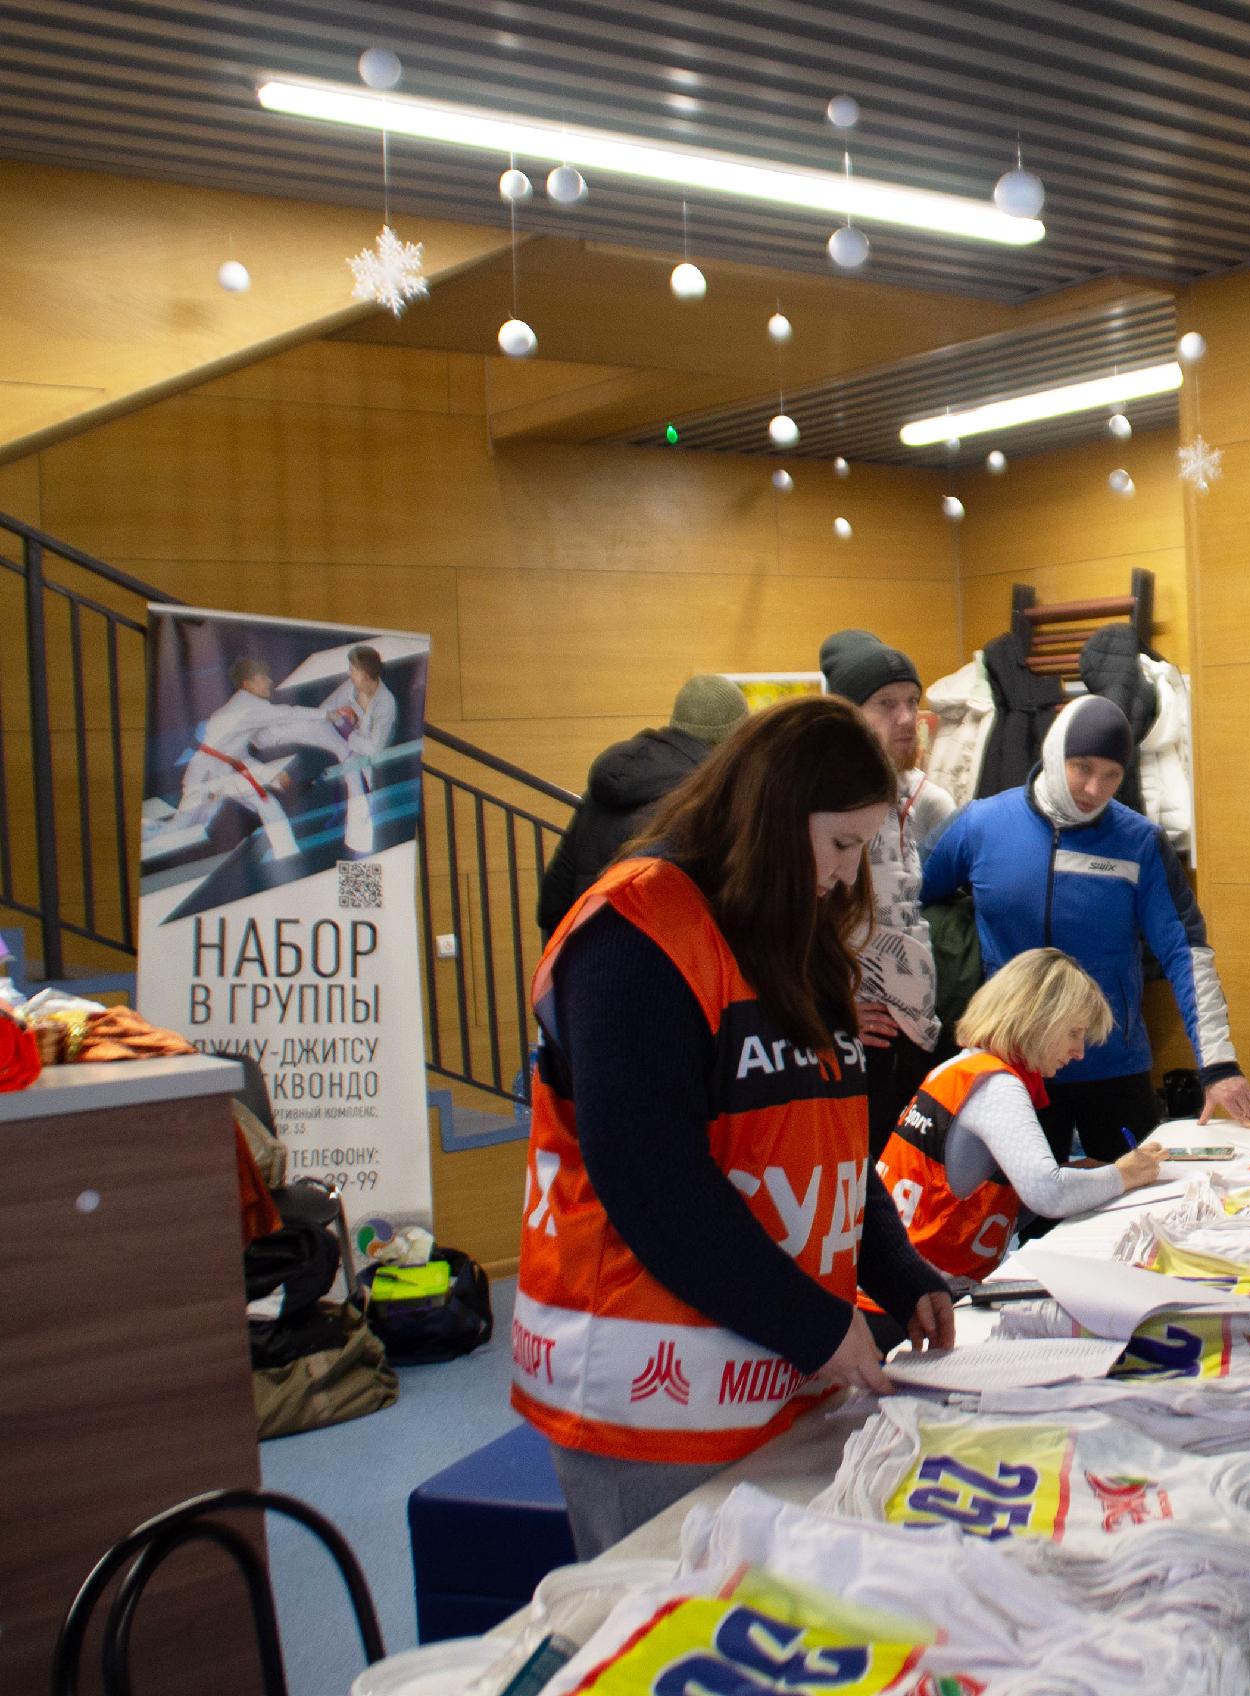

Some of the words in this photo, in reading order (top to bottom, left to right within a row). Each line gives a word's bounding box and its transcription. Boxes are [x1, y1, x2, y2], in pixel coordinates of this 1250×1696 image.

[193, 916, 378, 978] НАБОР
[190, 983, 212, 1025] В
[229, 983, 381, 1025] ГРУППЫ
[266, 1071, 379, 1100] КВОНДО
[292, 1147, 380, 1168] ТЕЛЕФОНУ:
